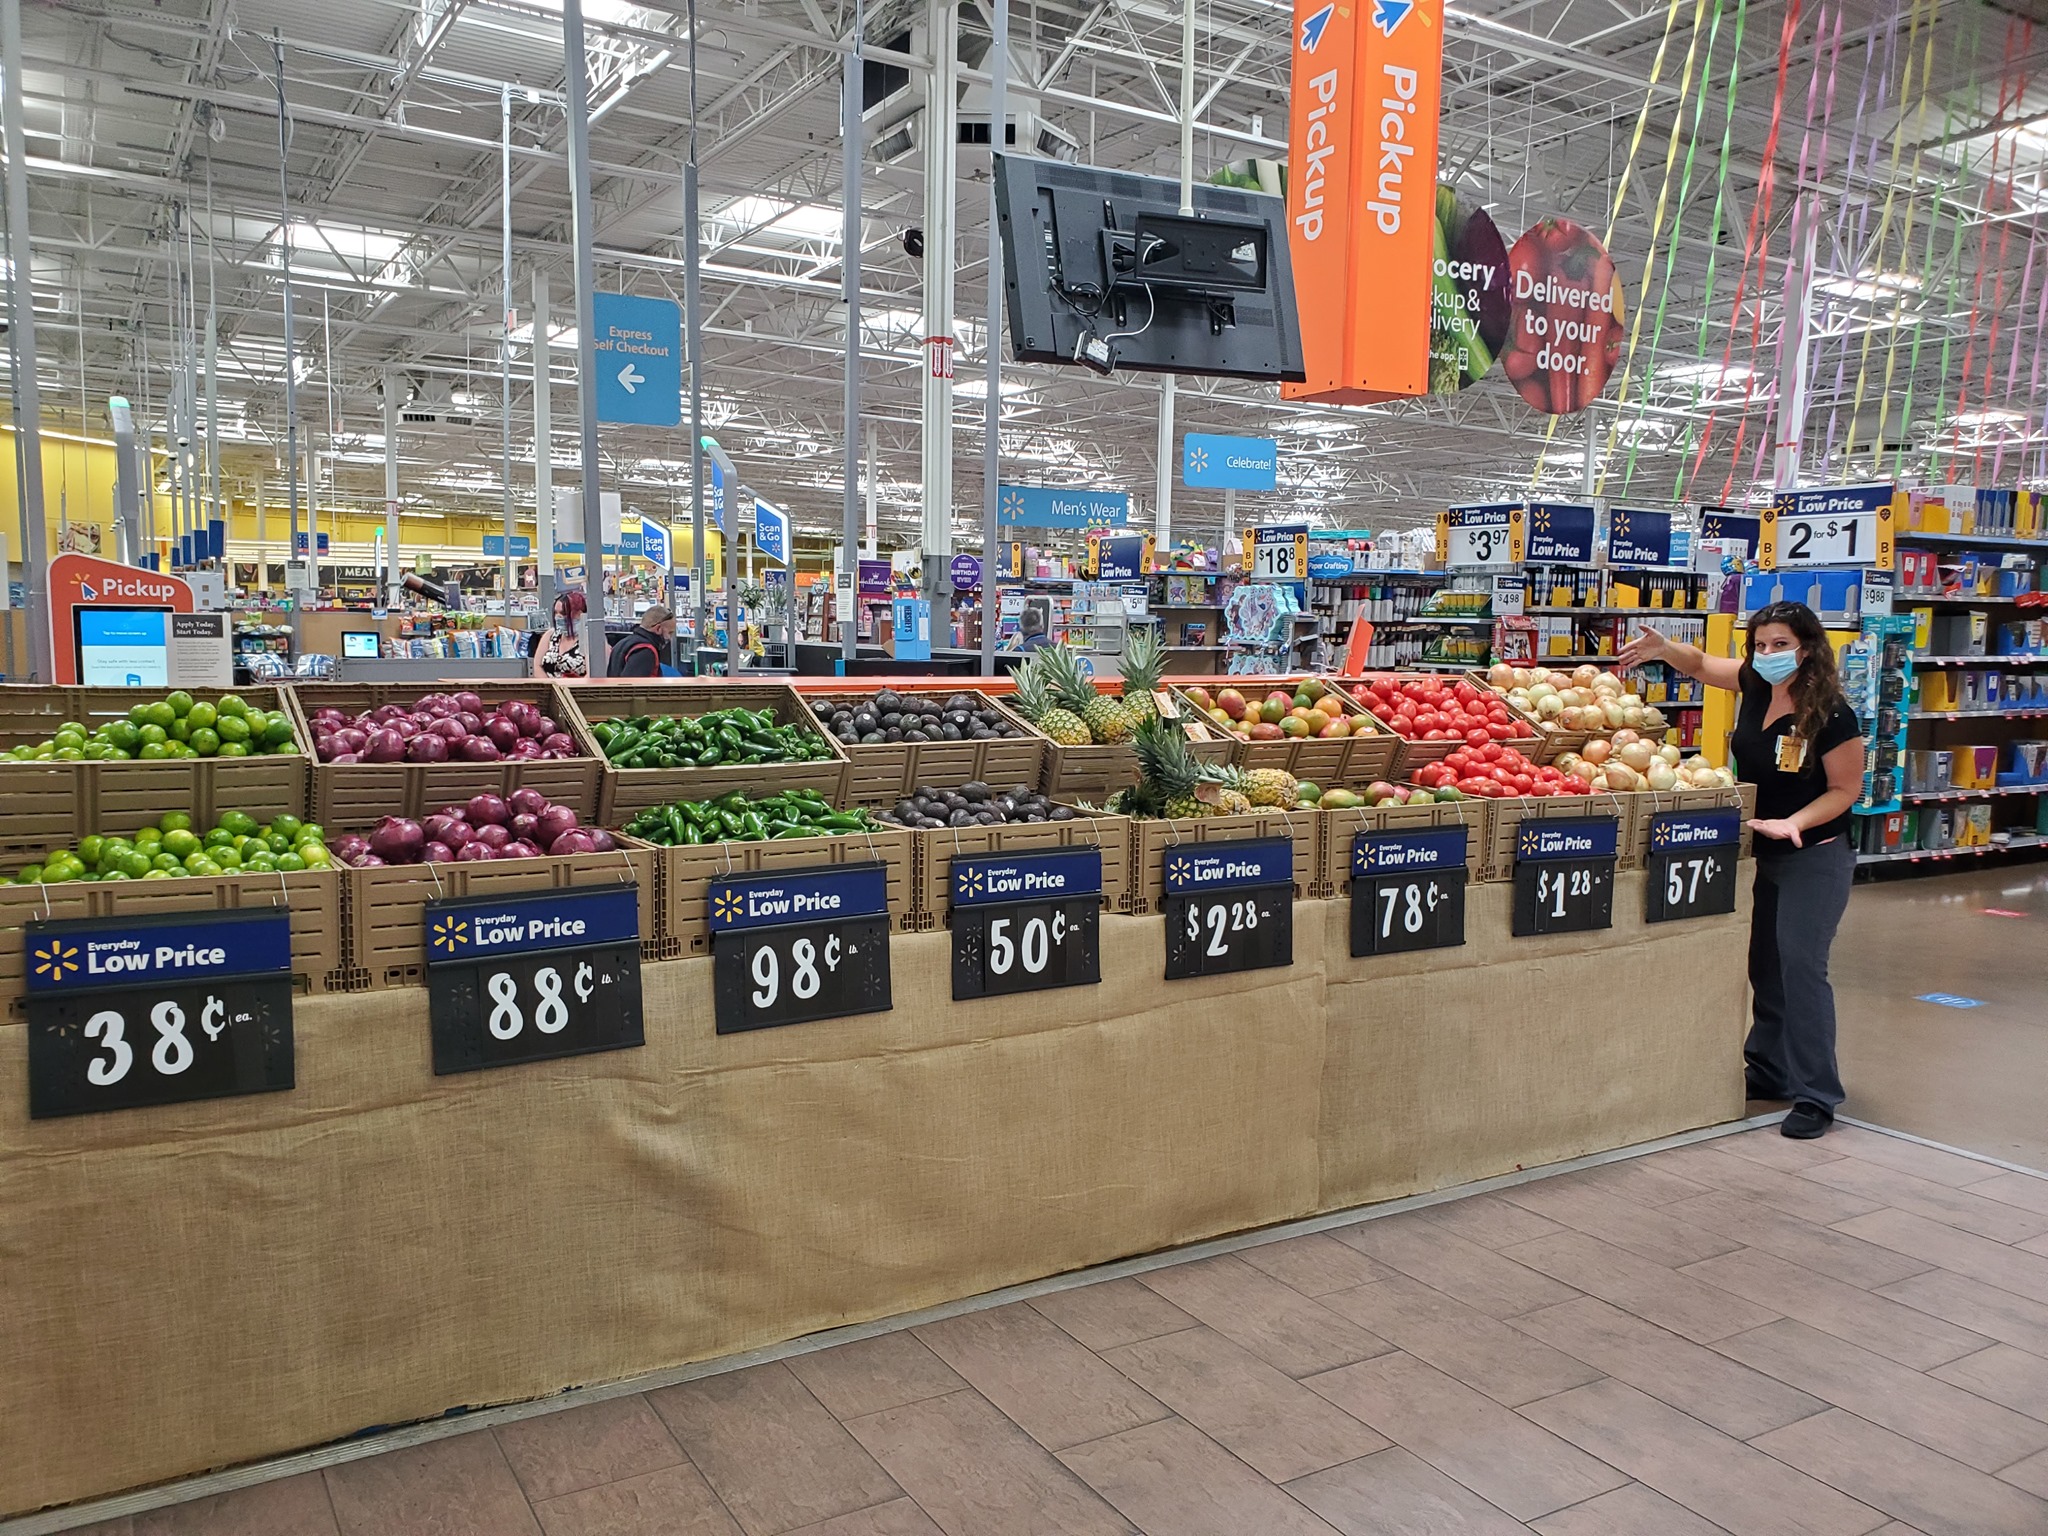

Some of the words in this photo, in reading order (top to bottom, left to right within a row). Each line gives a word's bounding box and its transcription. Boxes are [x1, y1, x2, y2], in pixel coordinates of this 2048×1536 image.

[1296, 69, 1338, 241] Pickup
[1366, 64, 1418, 235] Pickup
[1433, 258, 1495, 291] ocery
[1515, 270, 1614, 314] Delivered
[1430, 308, 1480, 340] livery
[1525, 309, 1548, 336] to
[1554, 318, 1601, 346] your
[609, 326, 653, 340] Express
[616, 341, 669, 357] Checkout
[1536, 342, 1590, 376] door.
[1226, 456, 1271, 470] Celebrate!
[1051, 500, 1087, 516] Men's
[1090, 502, 1121, 517] Wear
[1798, 500, 1827, 513] Low
[1828, 497, 1863, 511] Price
[1465, 514, 1482, 524] Low
[1484, 512, 1506, 523] Price
[759, 523, 780, 533] Scan
[645, 536, 662, 544] Scan
[1263, 534, 1276, 542] Low
[1276, 532, 1293, 542] Price
[1514, 540, 1520, 548] B
[1788, 522, 1812, 559] 2
[1813, 531, 1825, 539] for
[1532, 543, 1555, 556] Low
[1555, 543, 1579, 557] Price
[1612, 547, 1633, 560] Low
[1634, 548, 1658, 561] Price
[1764, 543, 1772, 553] B
[1881, 542, 1889, 553] B
[1514, 552, 1520, 560] 7
[1764, 557, 1771, 566] 6
[1881, 557, 1888, 567] 5
[344, 567, 374, 577] MEAT
[1101, 568, 1114, 577] Low
[1115, 566, 1132, 577] Price
[1309, 562, 1323, 571] Paper
[1324, 561, 1349, 571] Crafting
[102, 578, 175, 602] Pickup
[176, 621, 194, 629] Apply
[195, 621, 216, 629] Today.
[1671, 830, 1693, 842] Low
[1693, 826, 1718, 840] Price
[1379, 844, 1402, 852] Everyday
[1540, 839, 1564, 852] Low
[1565, 836, 1592, 850] Price
[1194, 857, 1220, 866] Everyday
[1378, 852, 1405, 866] Low
[1407, 848, 1438, 863] Price
[987, 868, 1017, 876] Everyday
[1194, 866, 1224, 881] Low
[1227, 861, 1261, 878] Price
[988, 877, 1022, 893] Low
[1025, 872, 1065, 889] Price
[749, 889, 784, 899] Everyday
[749, 899, 790, 917] Low
[793, 892, 841, 912] Price
[475, 914, 516, 926] Everyday
[475, 926, 524, 946] Low
[529, 917, 586, 940] Price
[88, 940, 140, 951] Everyday
[848, 944, 858, 955] lb.
[88, 952, 149, 974] Low
[155, 944, 225, 968] Price
[601, 974, 613, 984] lb.
[235, 1012, 252, 1023] ea.
